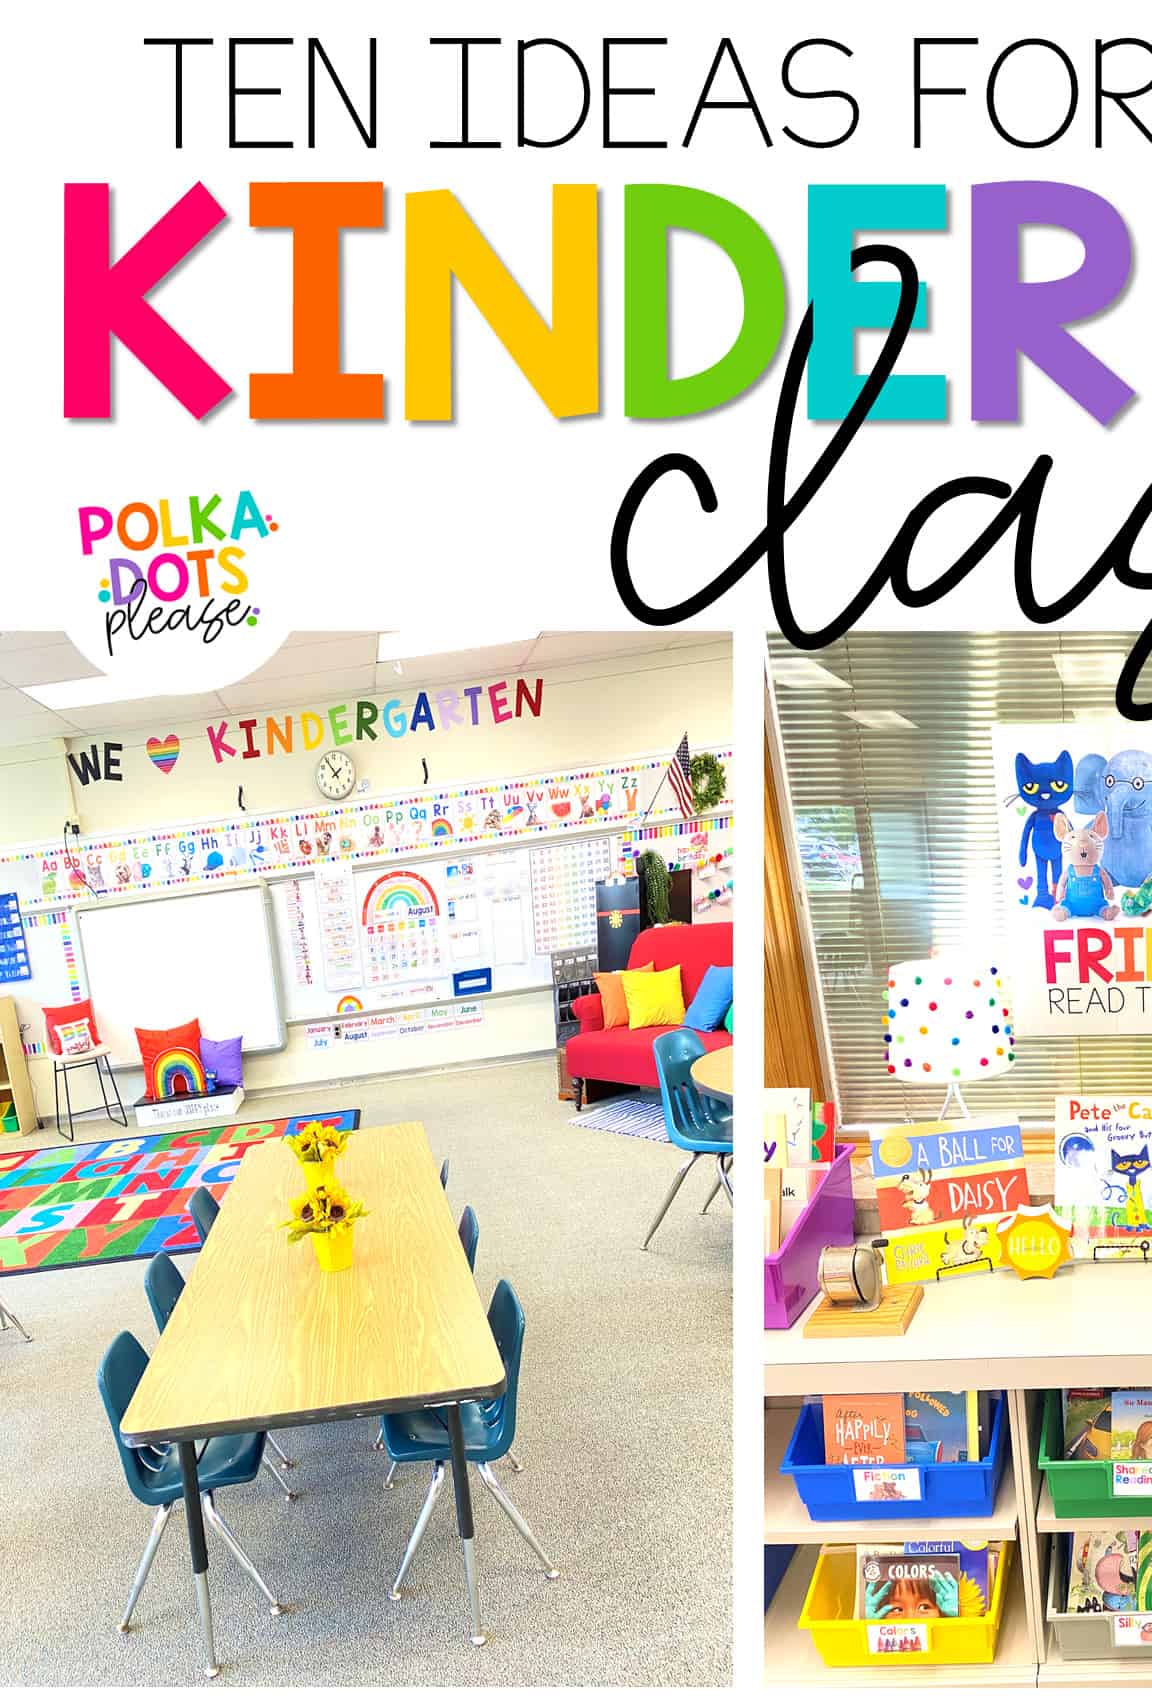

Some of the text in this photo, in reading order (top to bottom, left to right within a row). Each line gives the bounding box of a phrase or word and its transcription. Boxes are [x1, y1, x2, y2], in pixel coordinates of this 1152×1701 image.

[67, 678, 545, 785] WE KINDERGARTEN
[41, 860, 58, 872] Aa
[86, 853, 103, 866] Cc
[155, 843, 171, 857] Ff
[178, 840, 196, 855] Gg
[201, 837, 219, 850] Hh
[249, 830, 262, 845] Jj
[270, 827, 288, 840] Kk
[314, 820, 337, 833] Mm
[363, 814, 380, 826] Oo
[386, 810, 403, 824] Pp
[409, 807, 427, 821] Qq
[433, 803, 449, 817] Rr
[457, 800, 472, 813] Ss
[481, 797, 494, 810] Tt
[503, 794, 520, 806] Uu
[526, 790, 544, 802] Vv
[549, 787, 570, 799] Ww
[598, 780, 614, 794] Yy
[621, 776, 638, 789] Zz
[408, 905, 434, 917] August
[1047, 987, 1126, 1015] READ
[370, 1016, 395, 1027] March
[431, 1008, 448, 1018] May
[460, 1005, 478, 1015] June
[313, 1038, 328, 1048] July
[344, 1031, 368, 1042] August
[399, 1024, 425, 1034] October
[1069, 1100, 1112, 1121] Pete
[1113, 1103, 1126, 1113] the
[1084, 1124, 1099, 1133] and
[96, 1139, 145, 1159] B
[169, 1131, 209, 1149] C
[231, 1124, 275, 1141] D
[917, 1135, 1016, 1168] A BALL FOR
[76, 1156, 133, 1178] G
[143, 1150, 200, 1171] H
[29, 1178, 113, 1207] M
[119, 1167, 182, 1195] N
[948, 1175, 1019, 1214] DAISY
[16, 1192, 162, 1234] S T
[1008, 1235, 1060, 1257] HELLO
[835, 1419, 892, 1446] HAPPILY
[864, 1471, 906, 1481] Fiction
[908, 1541, 954, 1553] Colorful
[888, 1565, 936, 1579] COLORS
[879, 1626, 916, 1635] Colors
[1118, 1617, 1142, 1629] Silly
